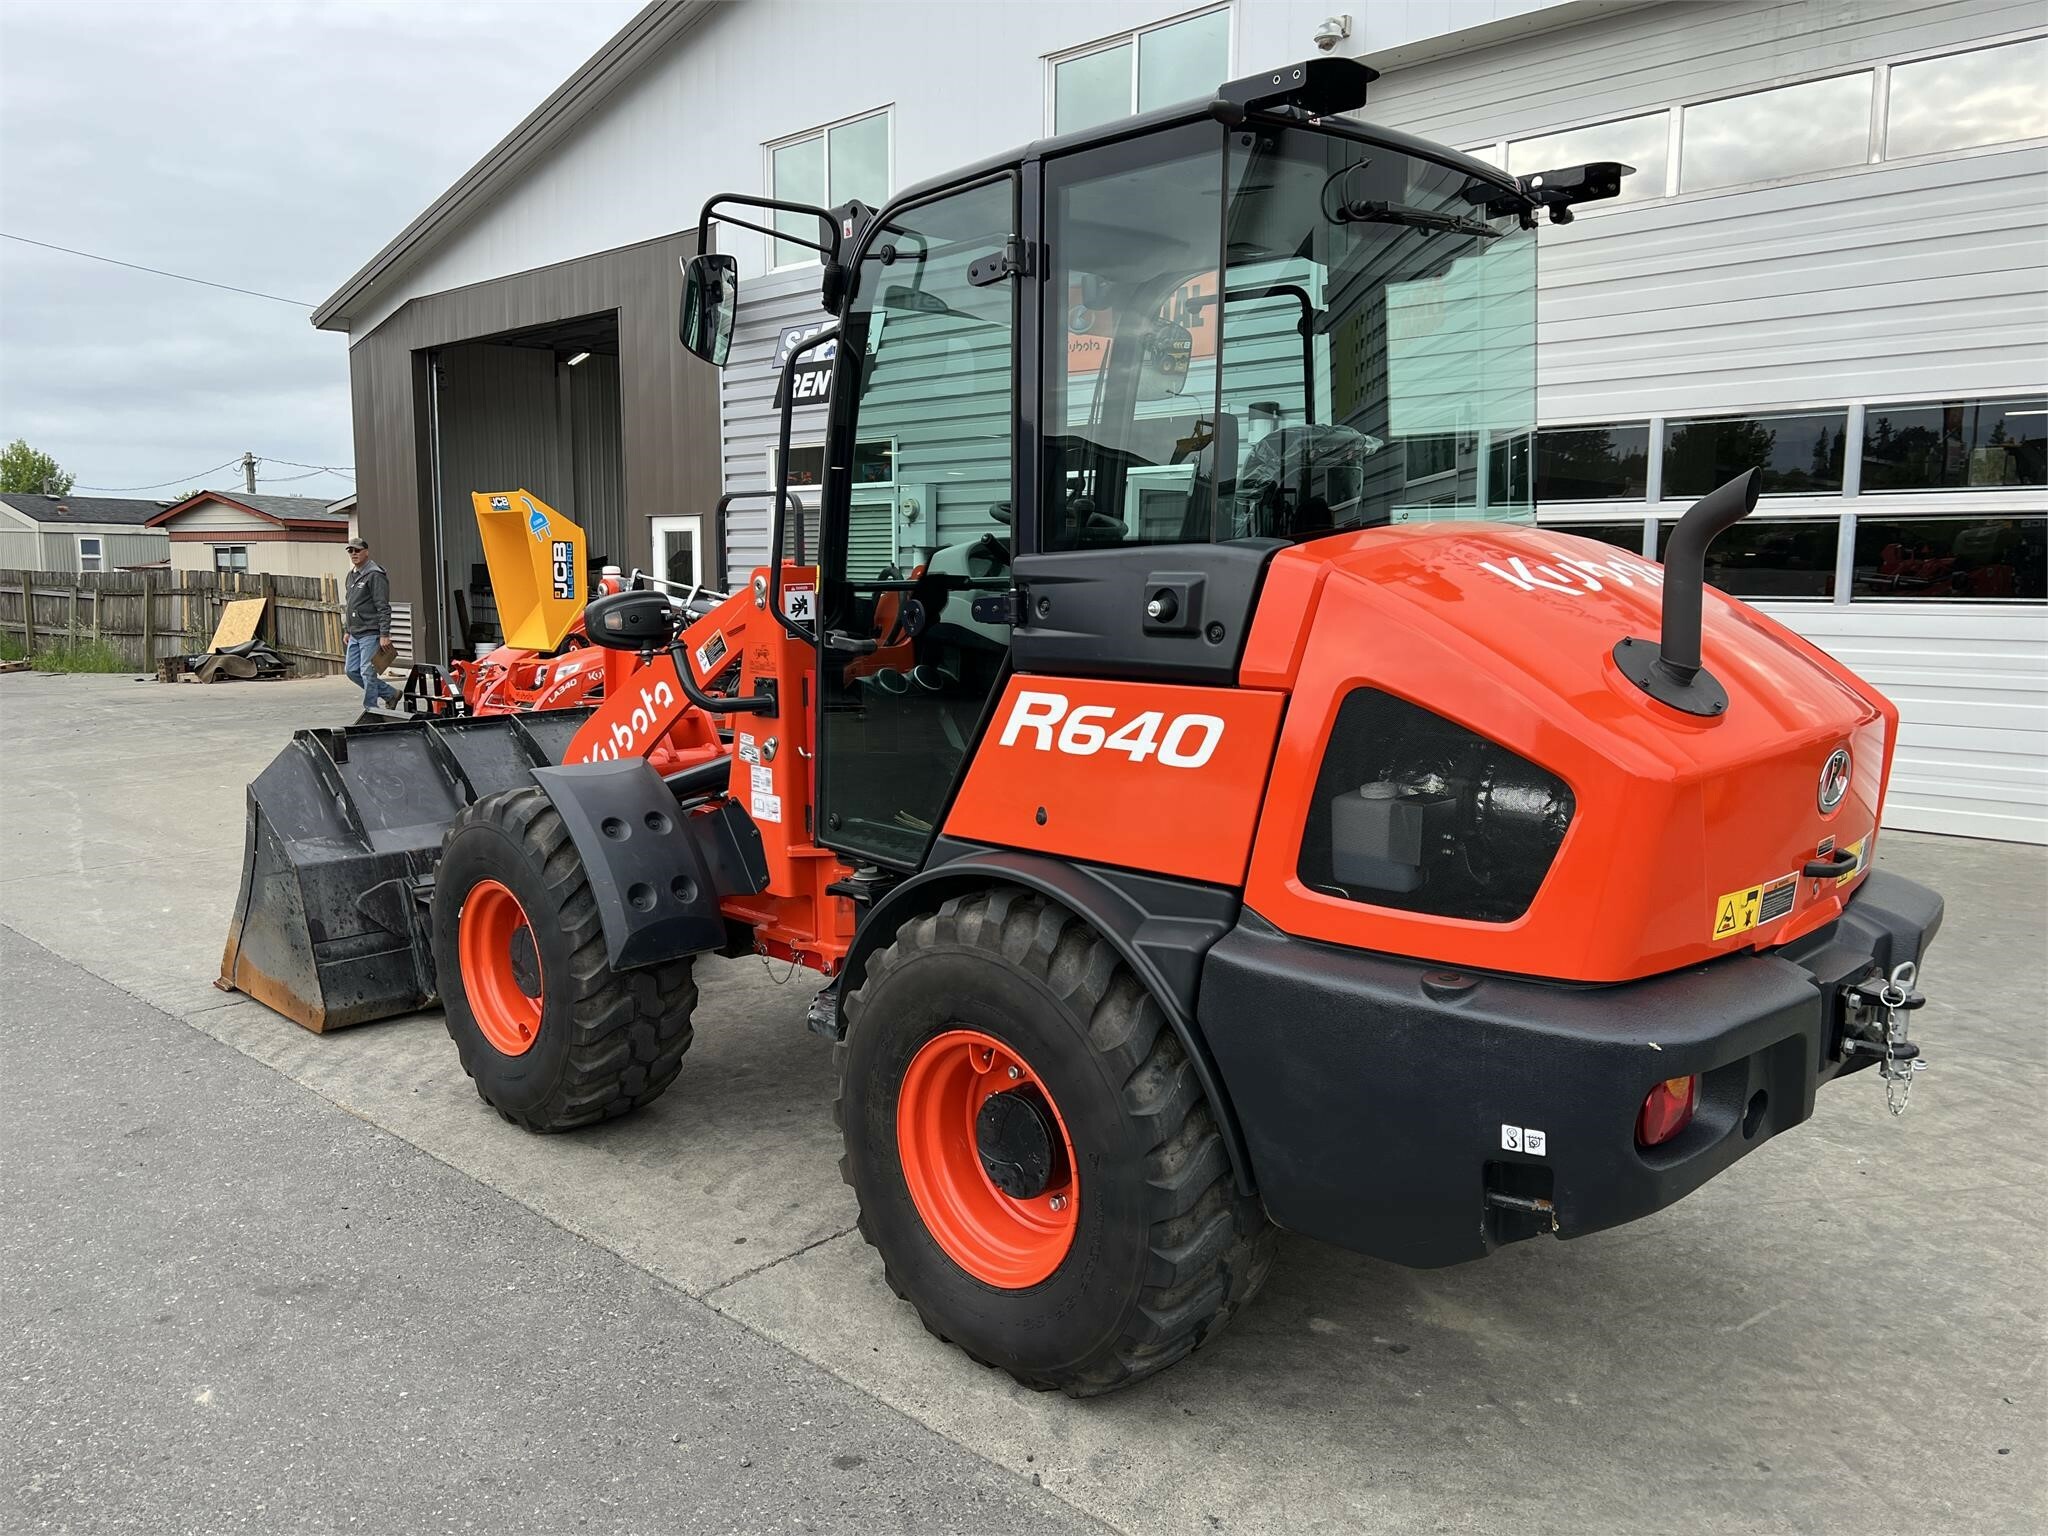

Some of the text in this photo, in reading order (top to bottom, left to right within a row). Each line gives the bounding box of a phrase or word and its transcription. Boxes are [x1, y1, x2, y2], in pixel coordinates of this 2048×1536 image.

[1069, 338, 1101, 353] ubota
[792, 369, 833, 399] REN
[491, 496, 509, 507] JCB
[553, 542, 568, 599] JCB
[566, 542, 574, 599] ELECTRIC
[548, 677, 578, 704] LA340
[998, 690, 1226, 769] R640
